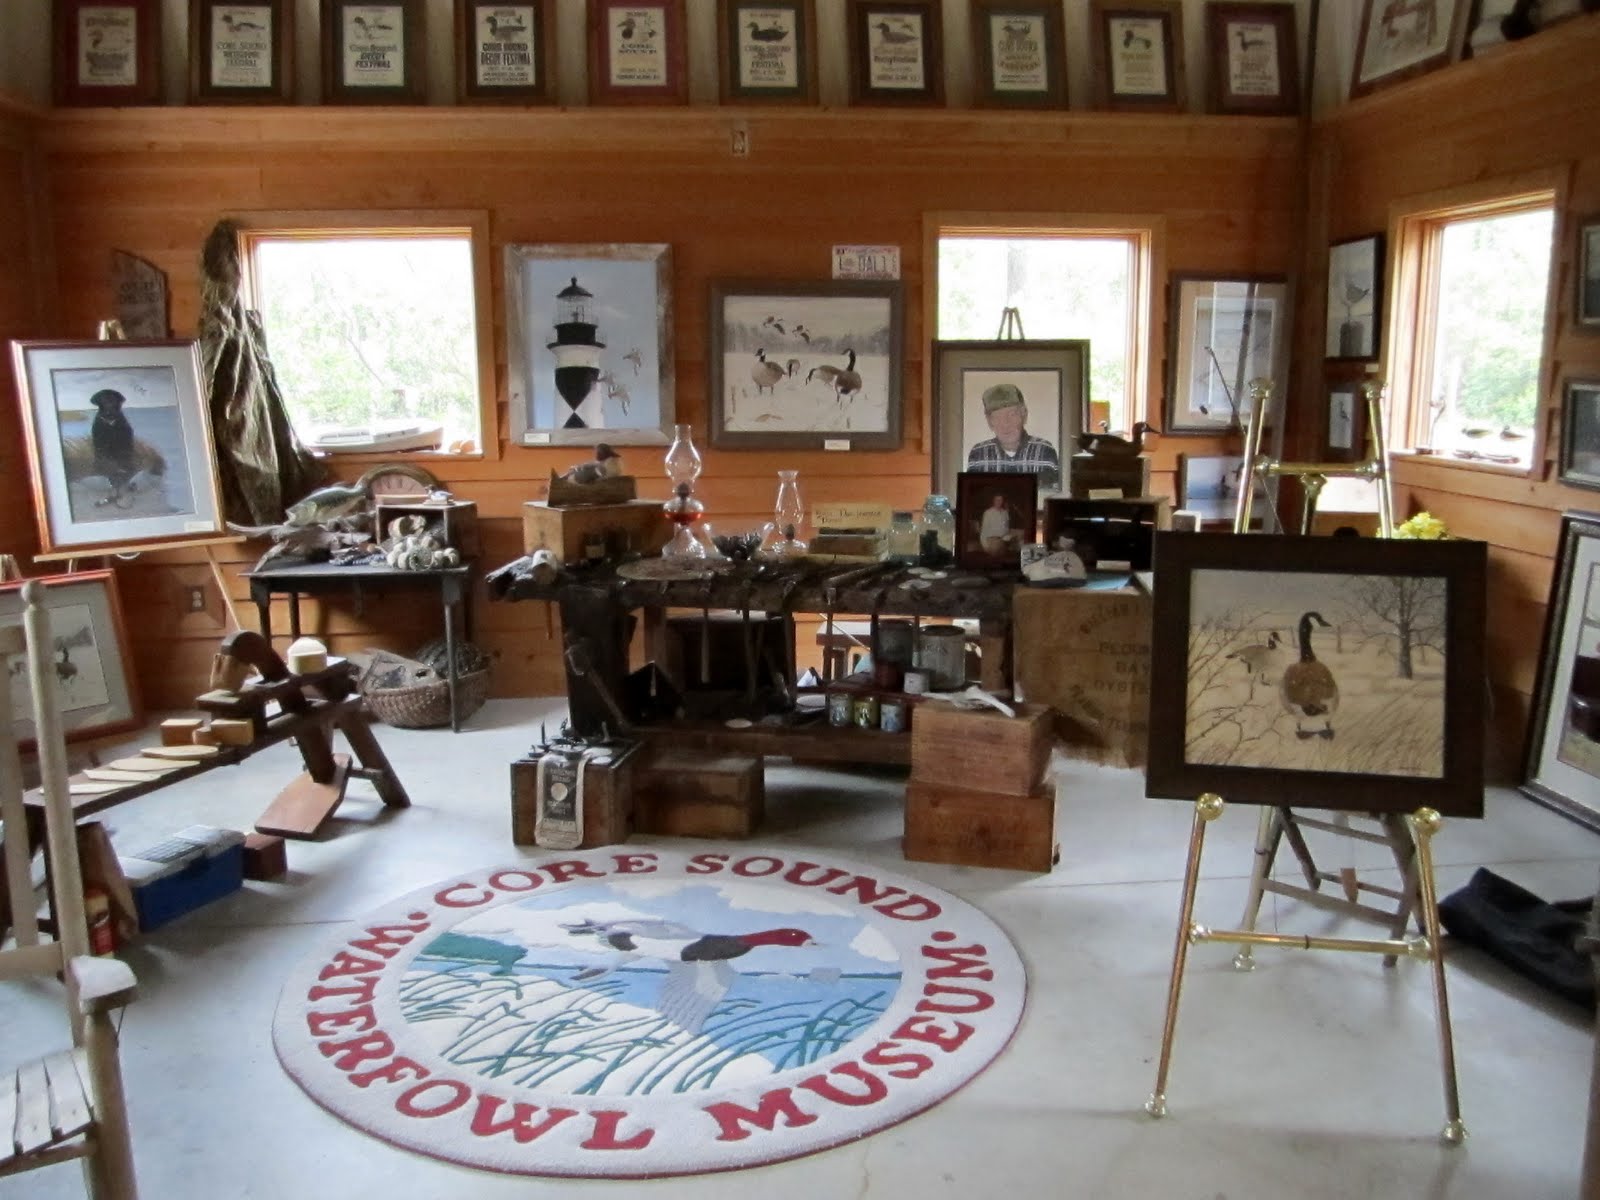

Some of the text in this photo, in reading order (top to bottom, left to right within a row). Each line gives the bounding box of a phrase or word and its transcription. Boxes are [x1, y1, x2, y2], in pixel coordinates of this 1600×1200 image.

[434, 853, 942, 923] CORE SOUND
[307, 920, 995, 1150] WATERFOWL MUSEUM
